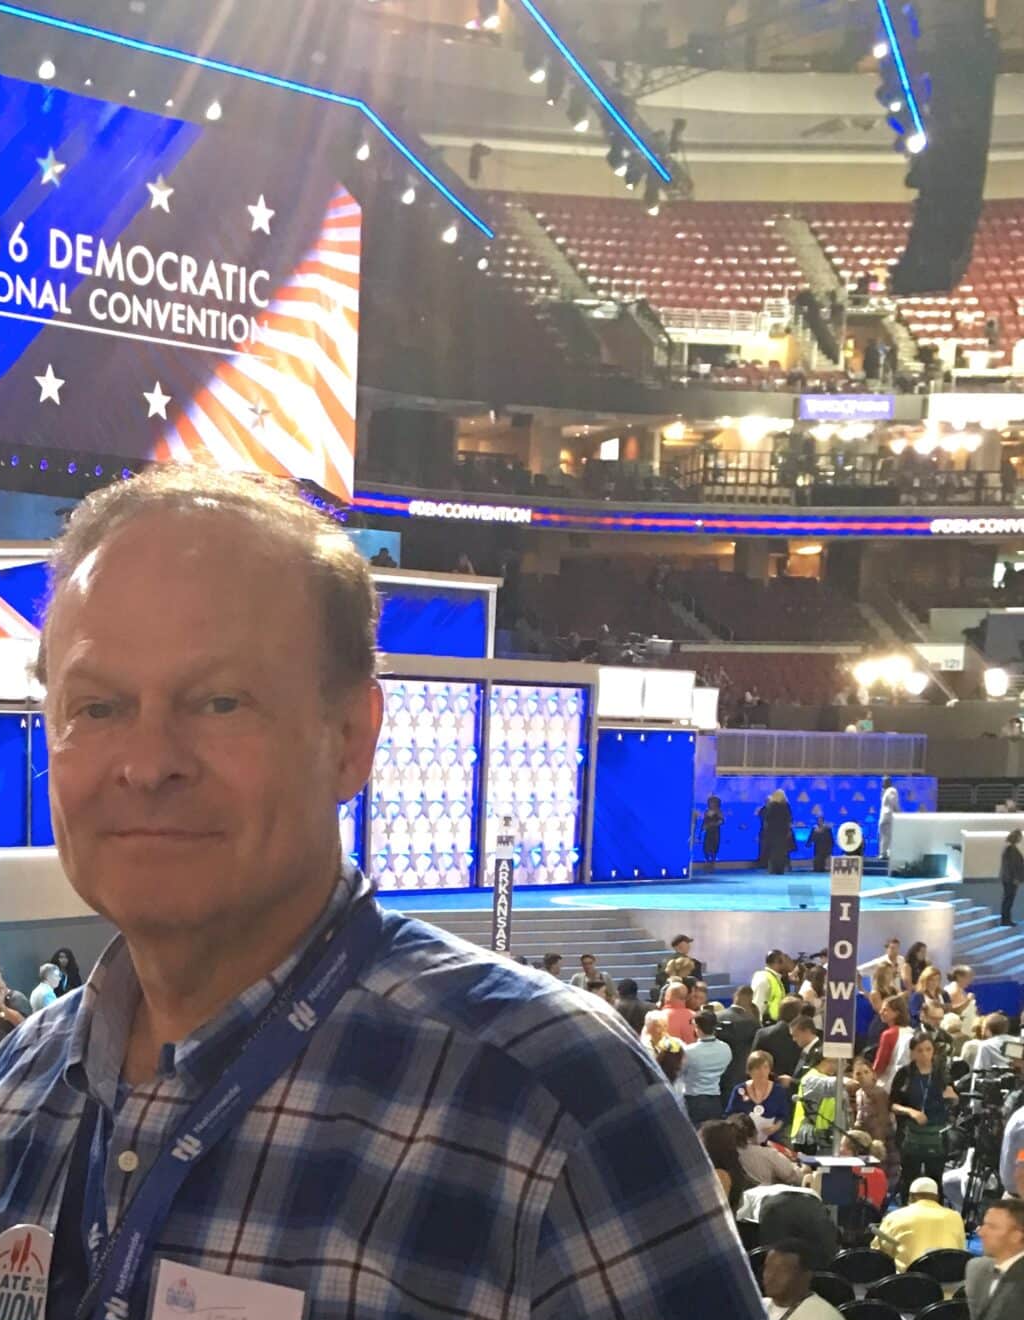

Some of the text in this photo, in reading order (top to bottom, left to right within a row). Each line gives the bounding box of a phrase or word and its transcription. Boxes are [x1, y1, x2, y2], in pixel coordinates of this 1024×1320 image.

[49, 228, 270, 308] DEMOCRATIC
[89, 289, 270, 346] CONVENTION
[495, 860, 510, 951] ARKANSAS
[829, 902, 854, 1037] IOWA
